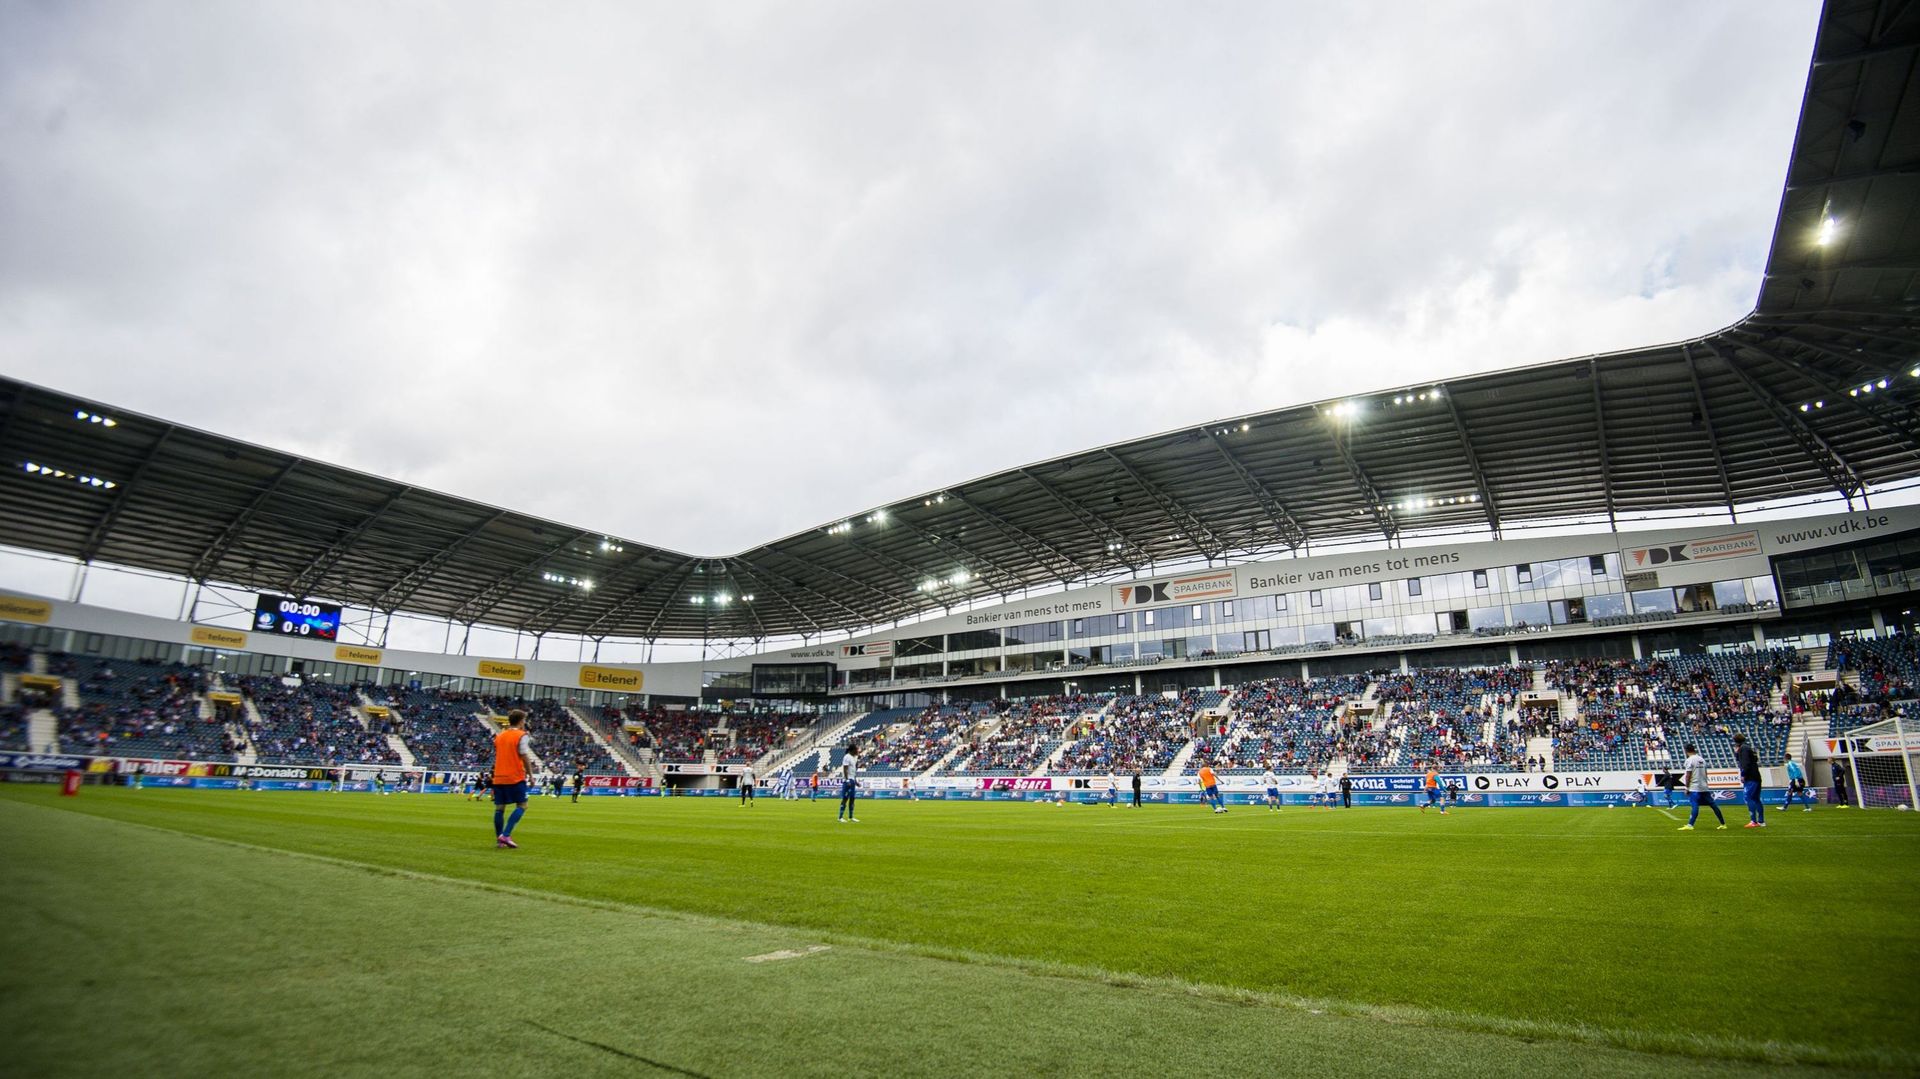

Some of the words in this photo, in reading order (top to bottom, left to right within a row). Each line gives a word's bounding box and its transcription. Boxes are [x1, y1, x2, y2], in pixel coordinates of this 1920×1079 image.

[1776, 515, 1889, 545] www.vdk.be
[1692, 539, 1757, 555] SPAARBANK
[1250, 574, 1303, 589] Bankier
[1308, 569, 1335, 581] van
[1339, 562, 1381, 577] mens
[1386, 557, 1410, 571] tot
[1414, 551, 1461, 567] mens
[1174, 579, 1233, 594] SPAARBANK
[280, 600, 321, 617] 00:00
[966, 612, 1003, 626] Bankier
[1003, 611, 1022, 622] van
[1024, 606, 1052, 618] mens
[1054, 603, 1070, 614] tot
[1072, 600, 1102, 612] mens
[207, 633, 243, 645] telenet
[349, 650, 378, 662] telenet
[790, 649, 835, 659] www.vdk.be
[491, 666, 521, 677] telenet
[598, 674, 638, 686] telenet
[232, 766, 307, 778] McDonald's
[1496, 778, 1530, 787] PLAY
[1566, 777, 1601, 787] PLAY
